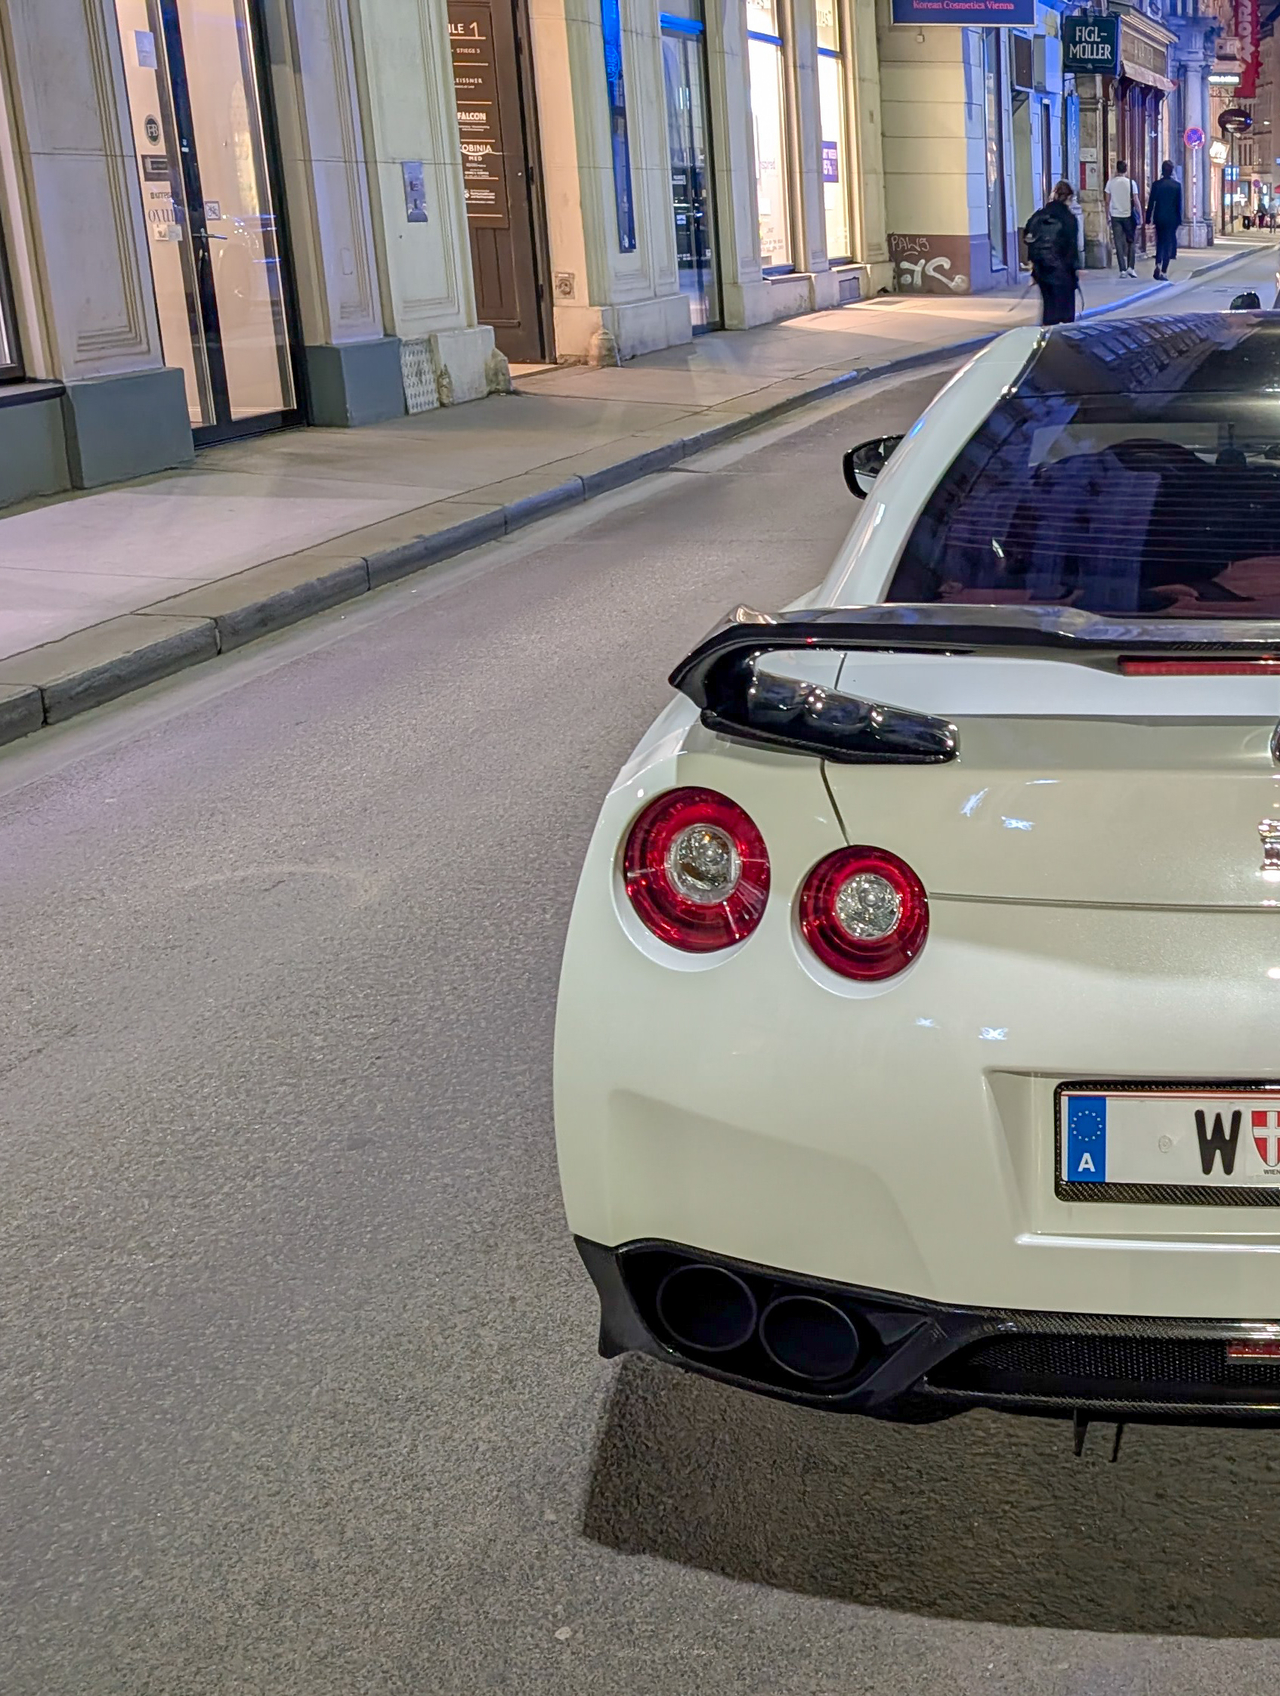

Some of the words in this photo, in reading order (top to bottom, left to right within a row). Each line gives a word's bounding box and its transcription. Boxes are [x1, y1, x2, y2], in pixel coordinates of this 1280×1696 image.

[913, 0, 942, 9] Korean
[943, 0, 985, 9] Cosmetics
[986, 0, 1014, 10] Vienna
[1075, 26, 1108, 42] FIGL-
[1069, 43, 1112, 59] MÜLLER
[457, 112, 487, 120] FALCON
[1194, 1109, 1243, 1176] W
[1077, 1153, 1096, 1173] A
